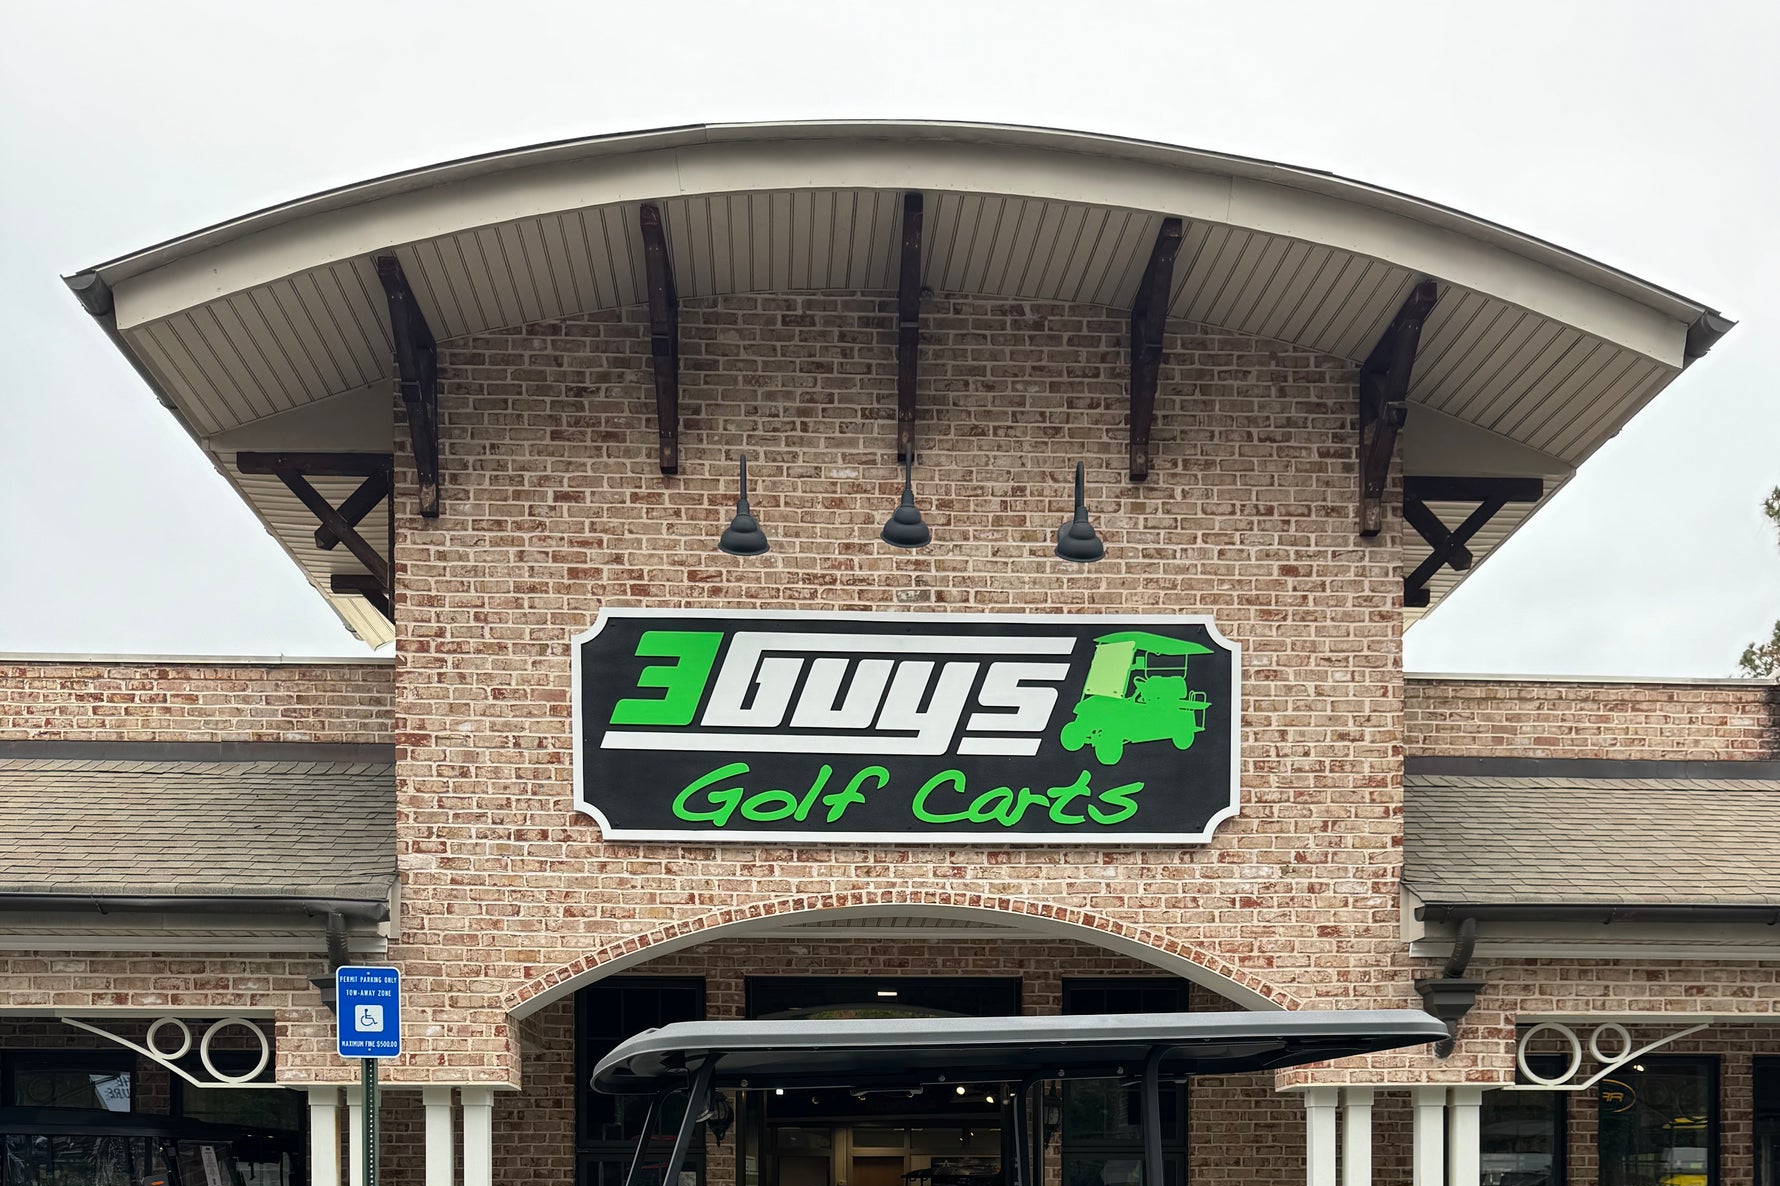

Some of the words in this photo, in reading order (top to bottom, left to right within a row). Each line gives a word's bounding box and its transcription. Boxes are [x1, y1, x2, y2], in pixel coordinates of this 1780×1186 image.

[671, 762, 890, 827] Golf
[912, 769, 1145, 826] Carts
[384, 976, 397, 984] ONLY
[346, 989, 375, 997] TOW-AWAY
[341, 1040, 364, 1048] MAXIMUM
[365, 1040, 375, 1048] FINE
